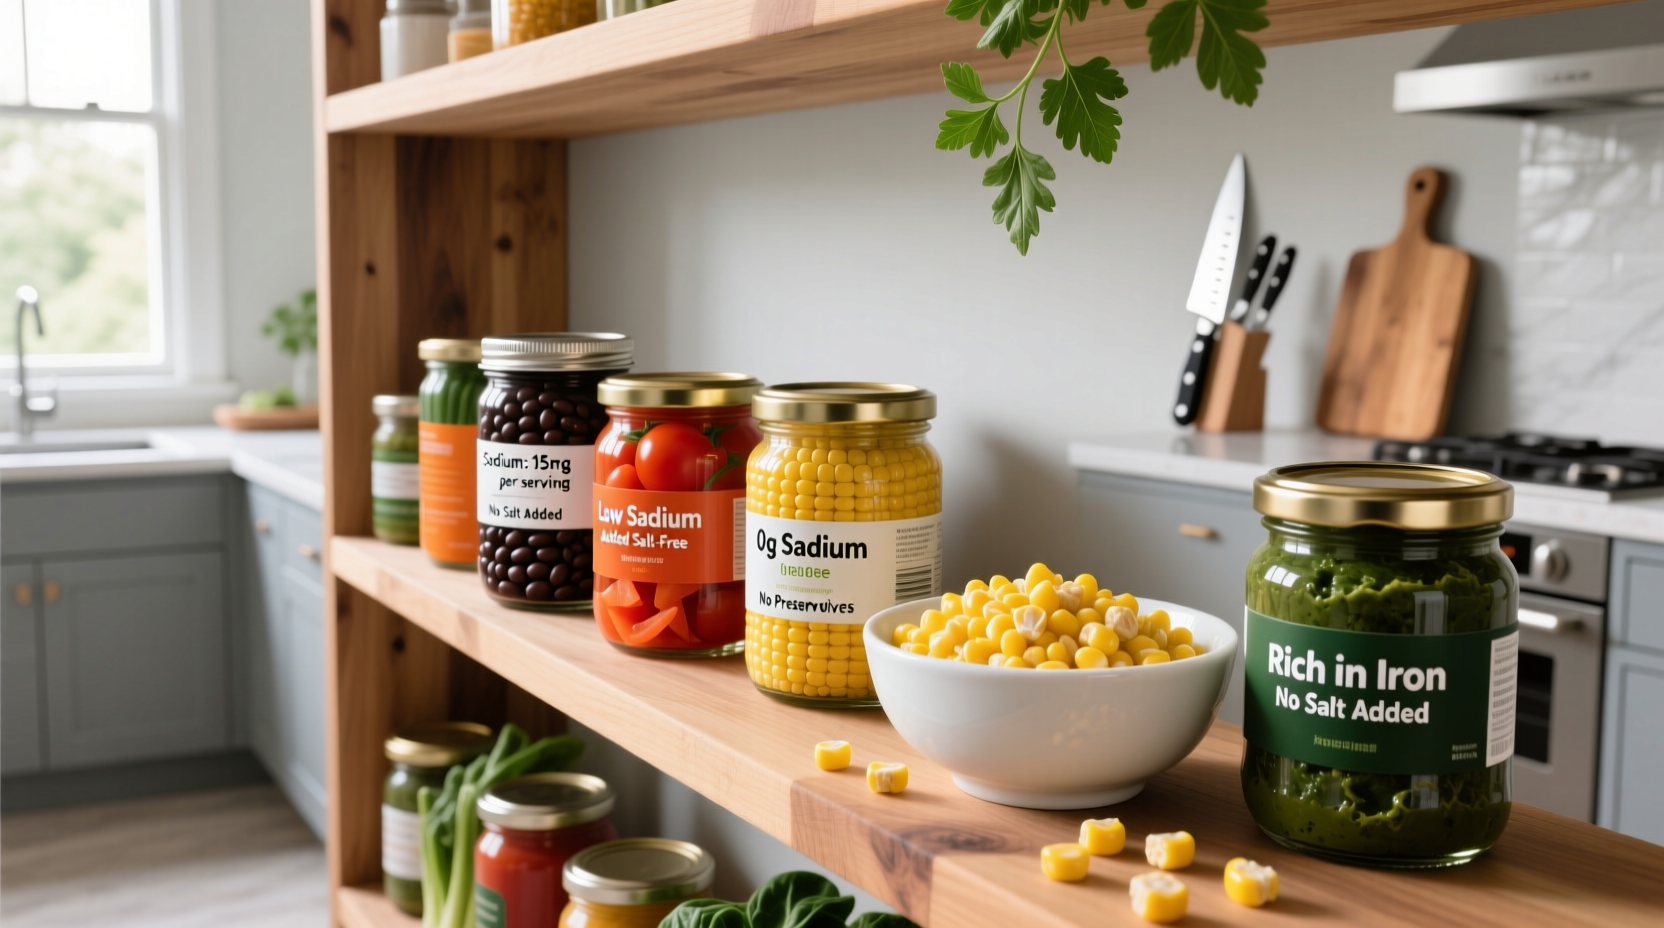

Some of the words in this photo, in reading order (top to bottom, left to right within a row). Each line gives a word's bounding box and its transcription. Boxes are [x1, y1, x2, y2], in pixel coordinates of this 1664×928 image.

[499, 477, 518, 491] per
[521, 475, 570, 493] serving
[524, 507, 562, 520] Added
[598, 500, 624, 526] Low
[627, 504, 702, 529] Sadium
[781, 532, 868, 559] Sadium
[759, 591, 772, 606] No
[1268, 642, 1326, 685] Rich
[1335, 653, 1367, 690] in
[1377, 658, 1447, 692] Iron
[1275, 685, 1301, 711] No
[1304, 691, 1346, 720] Salt
[1351, 699, 1430, 724] Added
